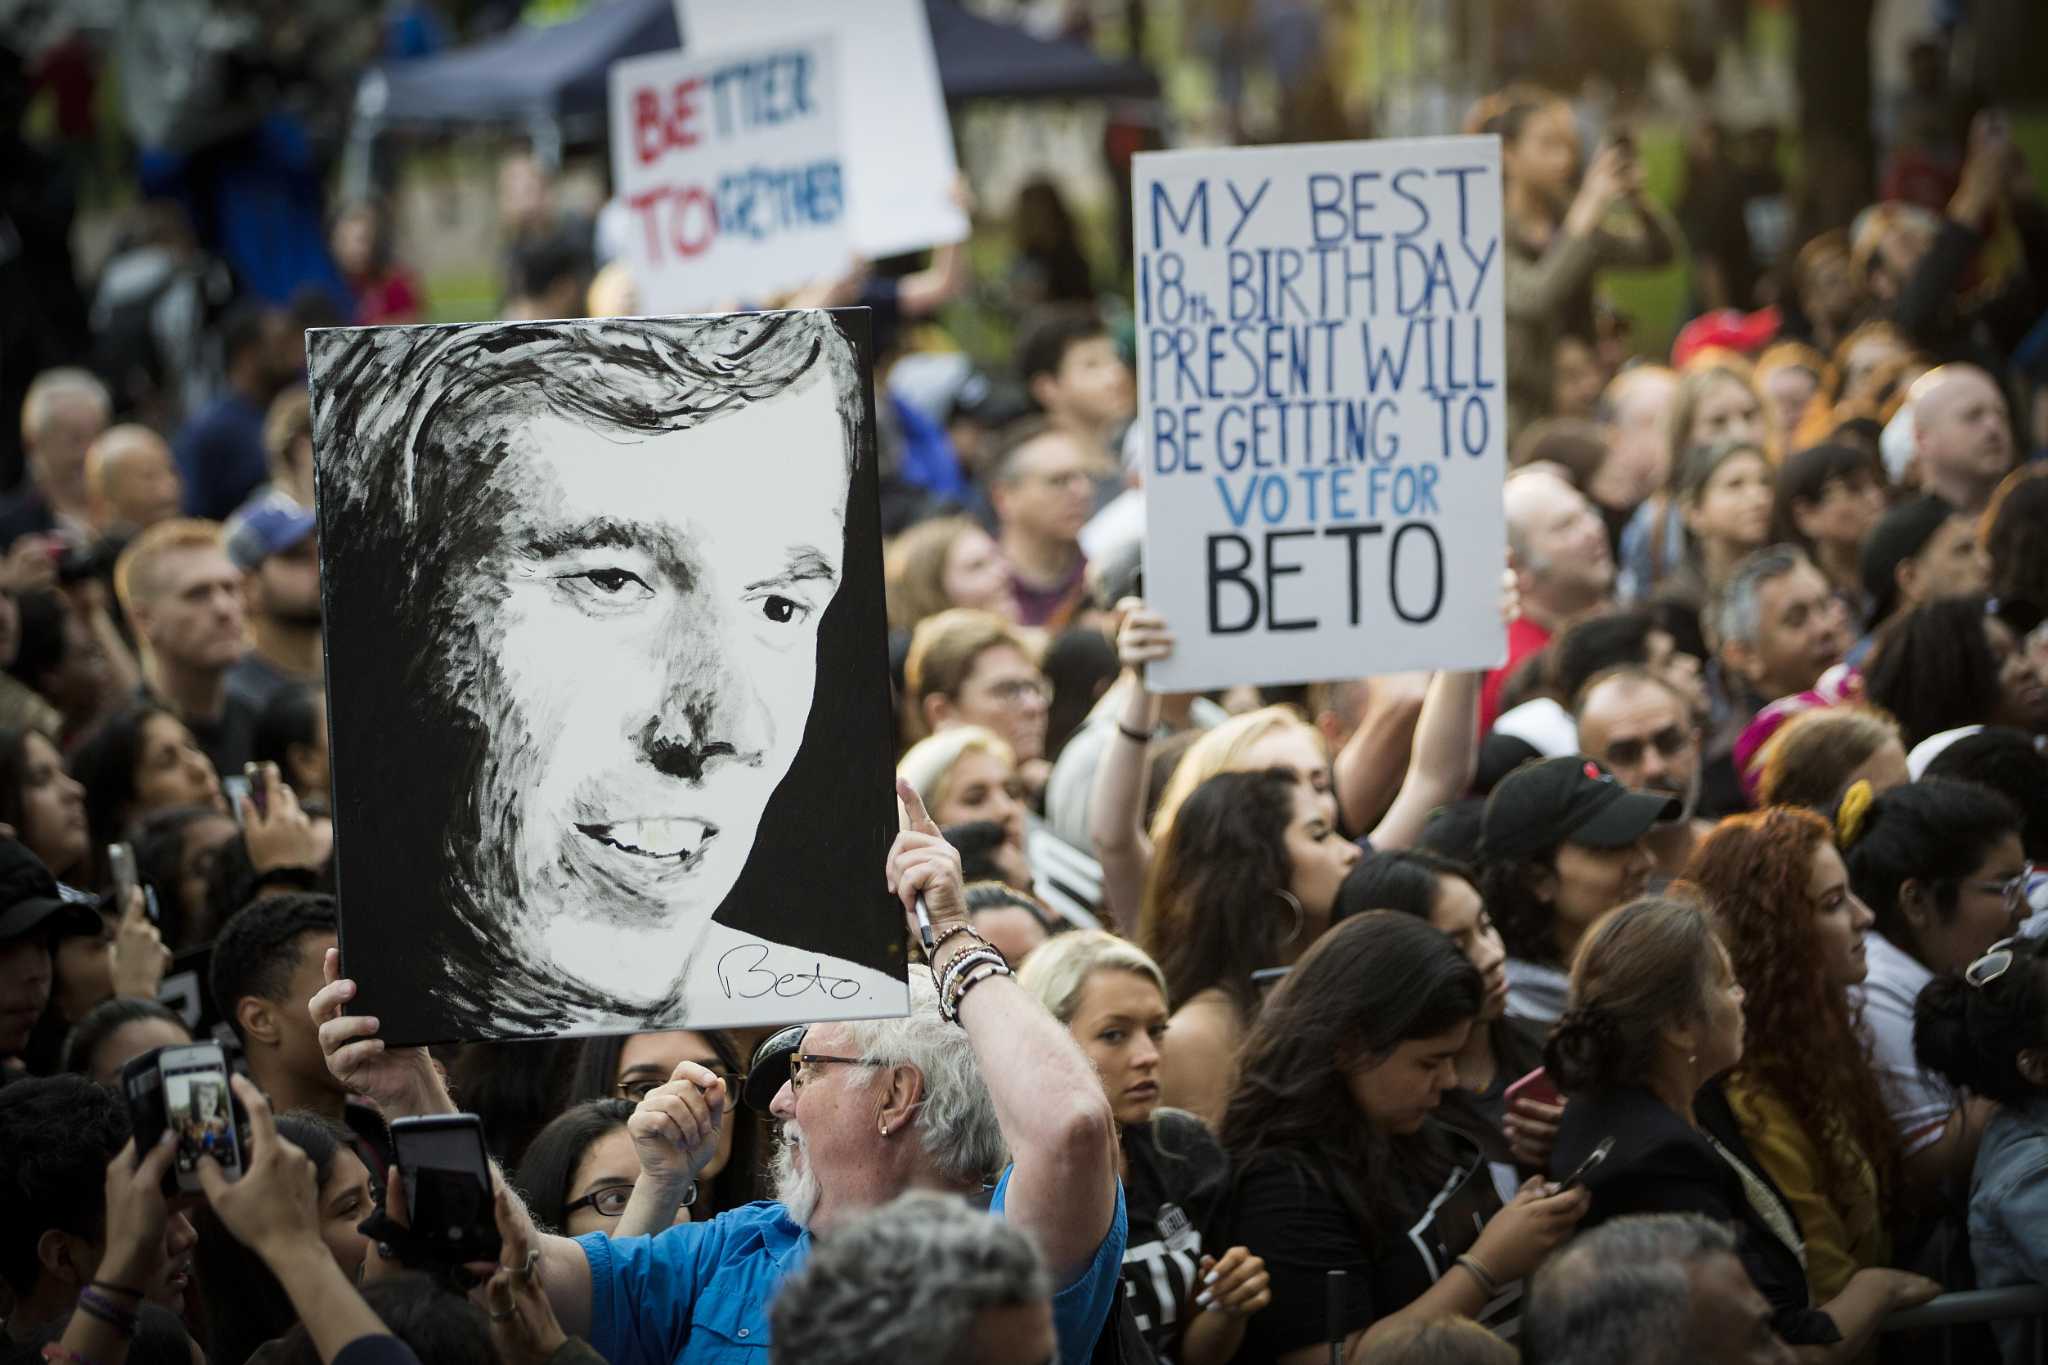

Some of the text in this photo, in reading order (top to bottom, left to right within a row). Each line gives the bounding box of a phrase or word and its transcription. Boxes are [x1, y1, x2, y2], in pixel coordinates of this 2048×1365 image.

[1150, 164, 1489, 250] MY BEST
[1148, 316, 1496, 403] PRESENT WILL
[1154, 391, 1489, 474] BE GETTING TO
[1216, 462, 1440, 527] VOTE FOR
[1206, 522, 1445, 635] BETO
